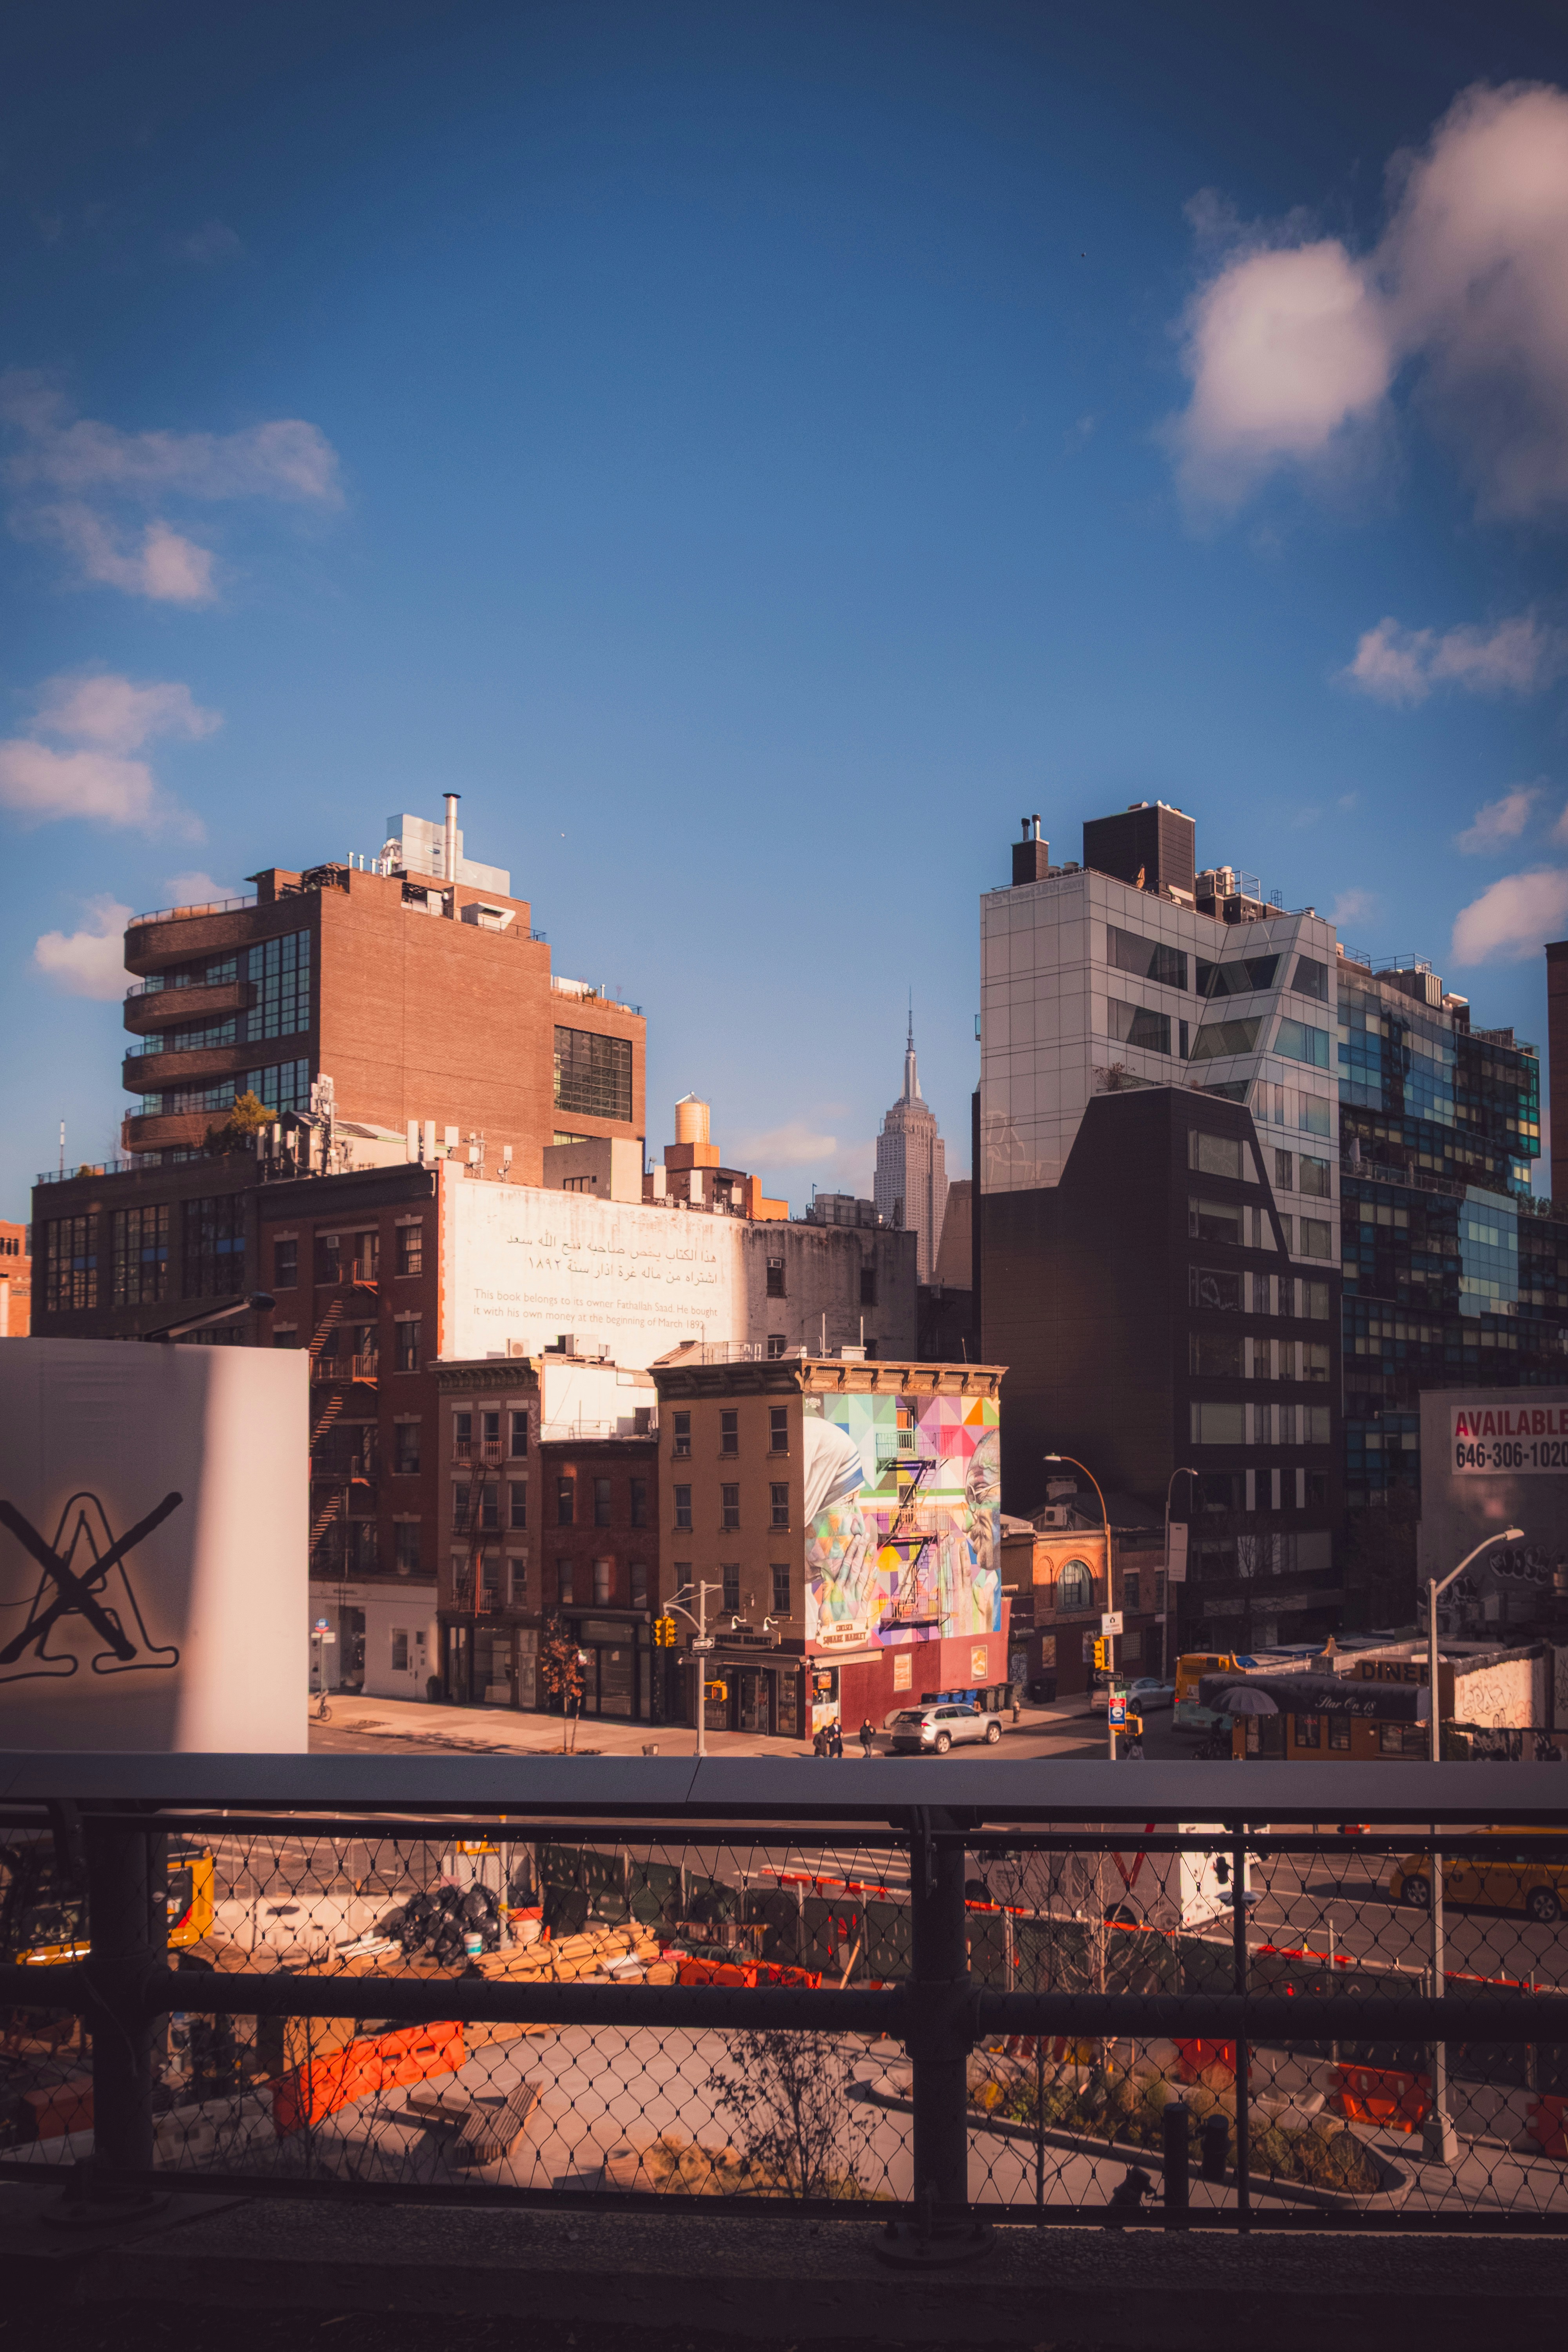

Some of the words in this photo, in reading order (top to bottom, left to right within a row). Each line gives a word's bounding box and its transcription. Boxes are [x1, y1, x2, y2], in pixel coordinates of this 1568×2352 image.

[506, 1235, 532, 1245] سعد
[538, 1230, 556, 1247] الله
[587, 1241, 625, 1256] صاحبه
[630, 1247, 661, 1262] يخص
[666, 1248, 697, 1264] الكتاب
[529, 1257, 561, 1270] ١٨٩٢
[701, 1250, 716, 1263] هذا
[567, 1259, 588, 1273] سنة
[593, 1262, 613, 1278] اذار
[619, 1265, 636, 1281] غرة
[642, 1267, 661, 1279] ماله
[666, 1271, 680, 1283] من
[686, 1271, 717, 1286] اشتراه
[474, 1288, 493, 1300] This
[497, 1290, 521, 1301] book
[524, 1293, 558, 1307] belongs
[561, 1296, 570, 1305] to
[573, 1297, 583, 1306] its
[586, 1299, 613, 1308] owner
[617, 1299, 652, 1311] Fathallah
[655, 1302, 675, 1313] Saad.
[677, 1305, 688, 1313] He
[691, 1305, 718, 1318] bought
[474, 1305, 480, 1315] it
[483, 1307, 503, 1316] with
[507, 1307, 519, 1317] his
[523, 1310, 542, 1319] own
[546, 1312, 575, 1323] money
[590, 1313, 603, 1323] the
[606, 1314, 644, 1328] beginning
[647, 1317, 655, 1325] of
[659, 1318, 683, 1328] March
[1455, 1409, 1568, 1437] AVAILABLE
[743, 1635, 772, 1646] MARKET
[823, 1635, 843, 1644] SQUARE
[845, 1632, 867, 1642] MARKET
[1344, 1697, 1359, 1710] On
[1363, 1701, 1376, 1711] 18
